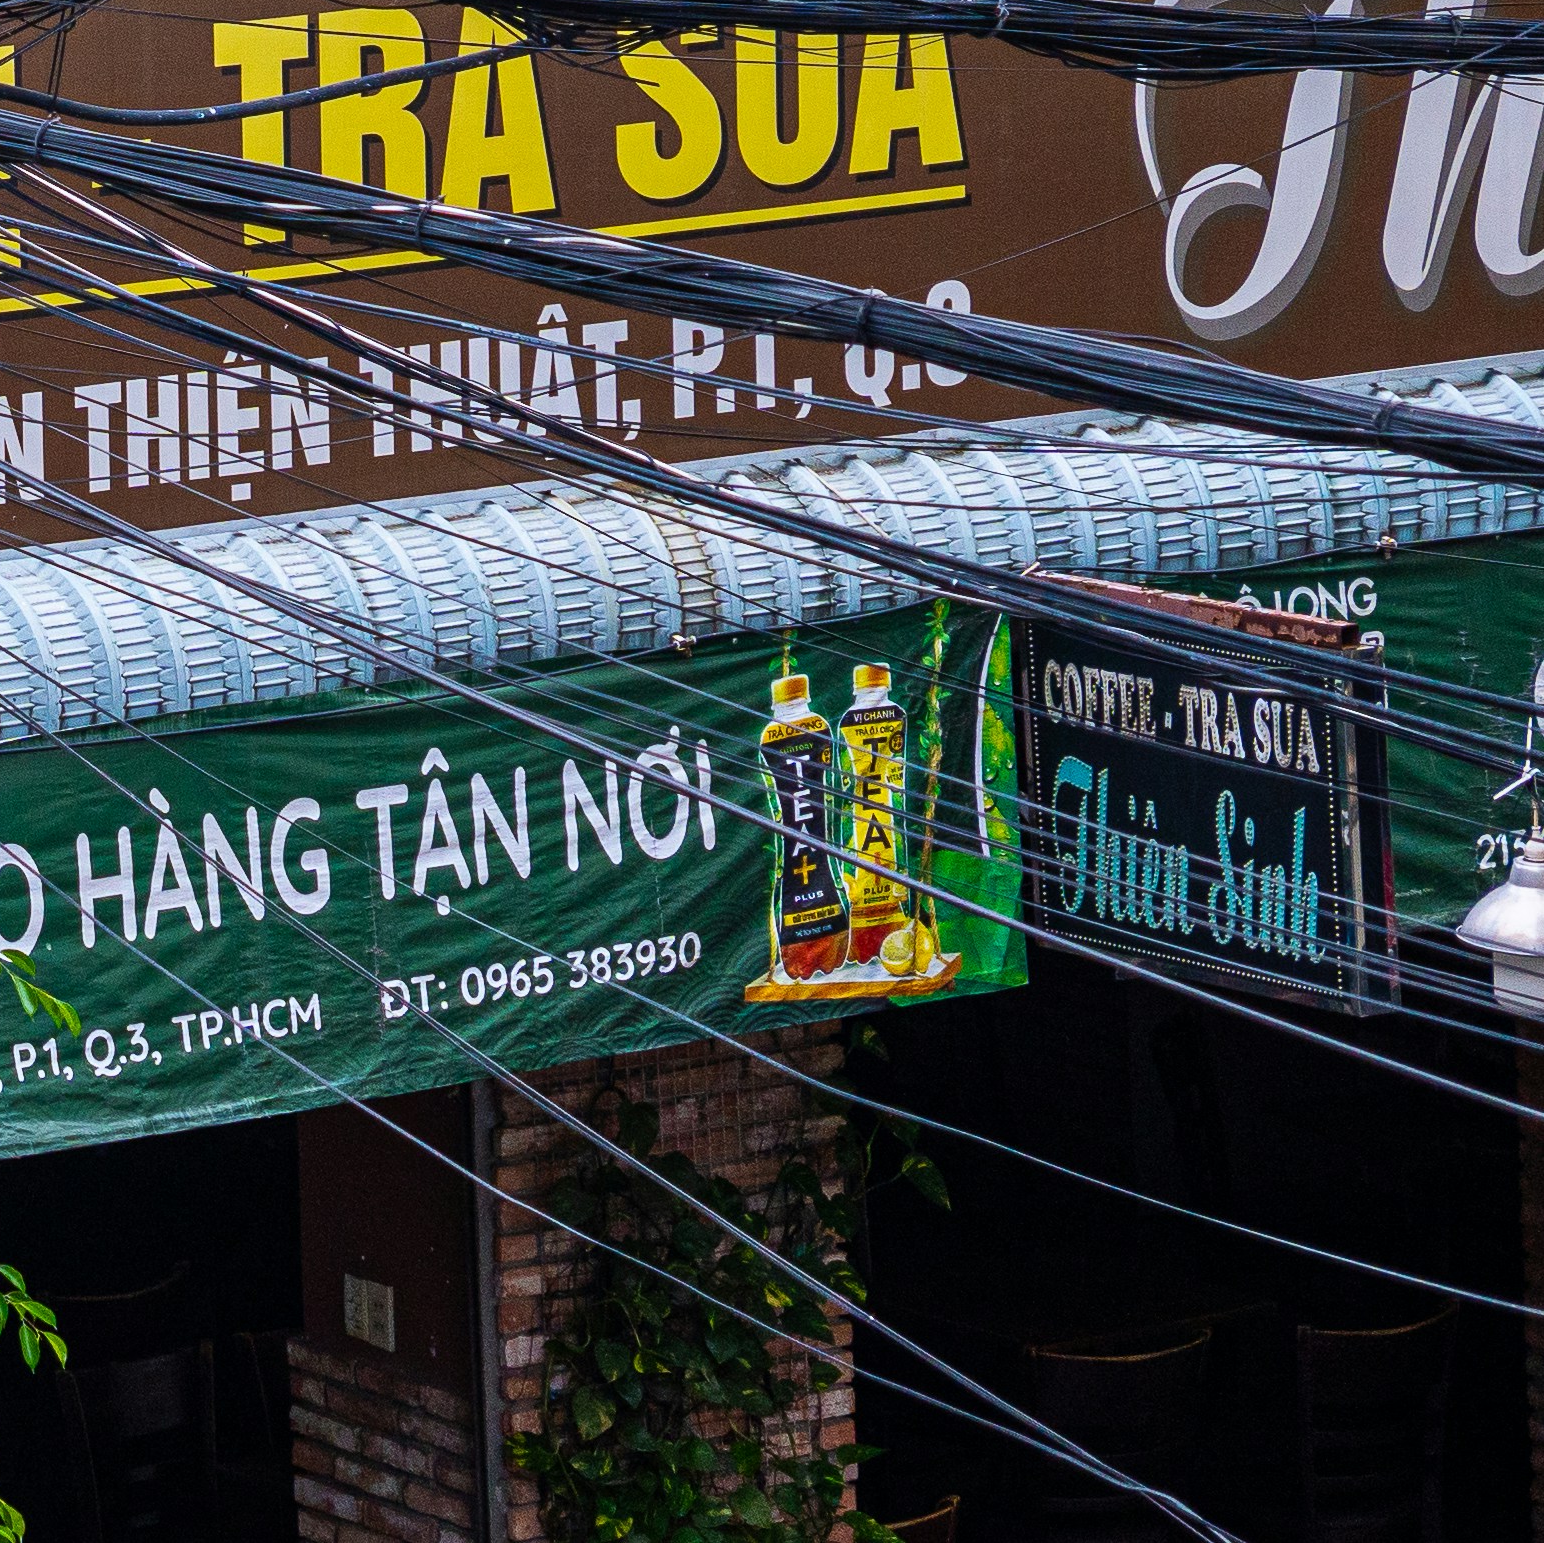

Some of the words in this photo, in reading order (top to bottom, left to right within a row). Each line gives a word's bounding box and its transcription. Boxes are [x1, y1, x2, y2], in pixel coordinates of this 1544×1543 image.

[74, 349, 333, 503] THIỆN
[863, 709, 895, 723] CHANH
[1044, 659, 1156, 740] COFFEE
[1178, 683, 1246, 759] TRA
[1252, 697, 1320, 774] SUA
[76, 787, 331, 946] HÀNG
[355, 747, 530, 916] TẬN
[794, 890, 824, 903] PLUS
[863, 884, 891, 895] PLUS
[13, 1039, 73, 1083] P.1,
[84, 1022, 162, 1079] Q.3,
[172, 992, 322, 1054] TP.HCM
[381, 973, 448, 1021] ĐT:
[460, 955, 555, 1006] 0965
[566, 930, 702, 986] 383930
